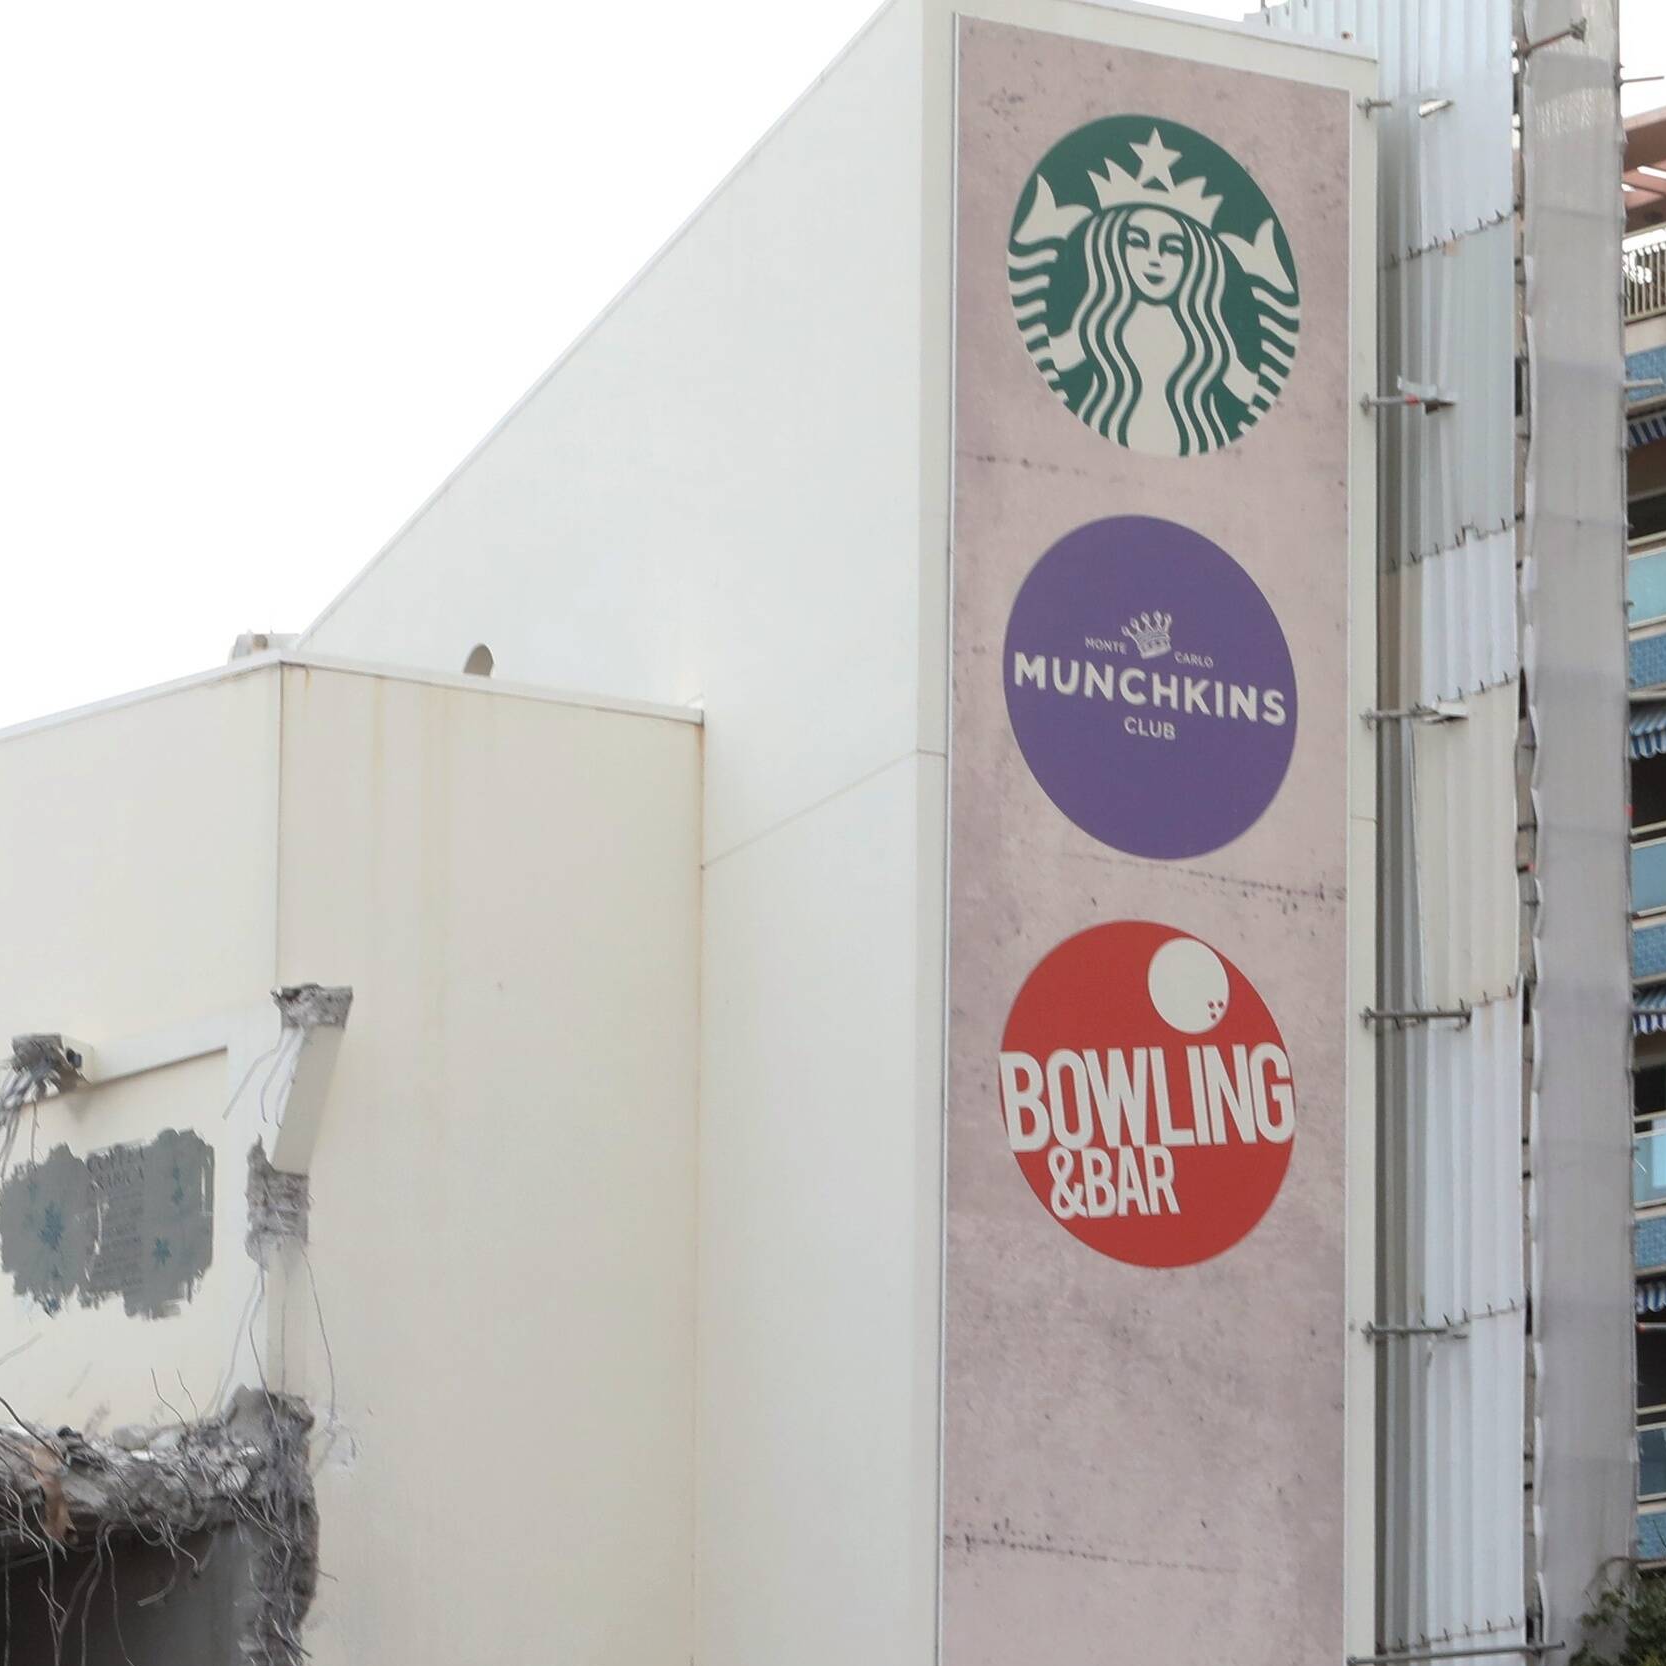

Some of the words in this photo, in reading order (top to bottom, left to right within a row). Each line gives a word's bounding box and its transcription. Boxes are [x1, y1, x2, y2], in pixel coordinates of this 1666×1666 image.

[1014, 651, 1286, 726] MUNCHKINS
[1085, 635, 1127, 656] MONTE
[1174, 650, 1214, 669] CARLO
[1123, 715, 1176, 741] CLUB
[999, 1042, 1295, 1152] BOWLING
[1047, 1144, 1181, 1220] &BAR
